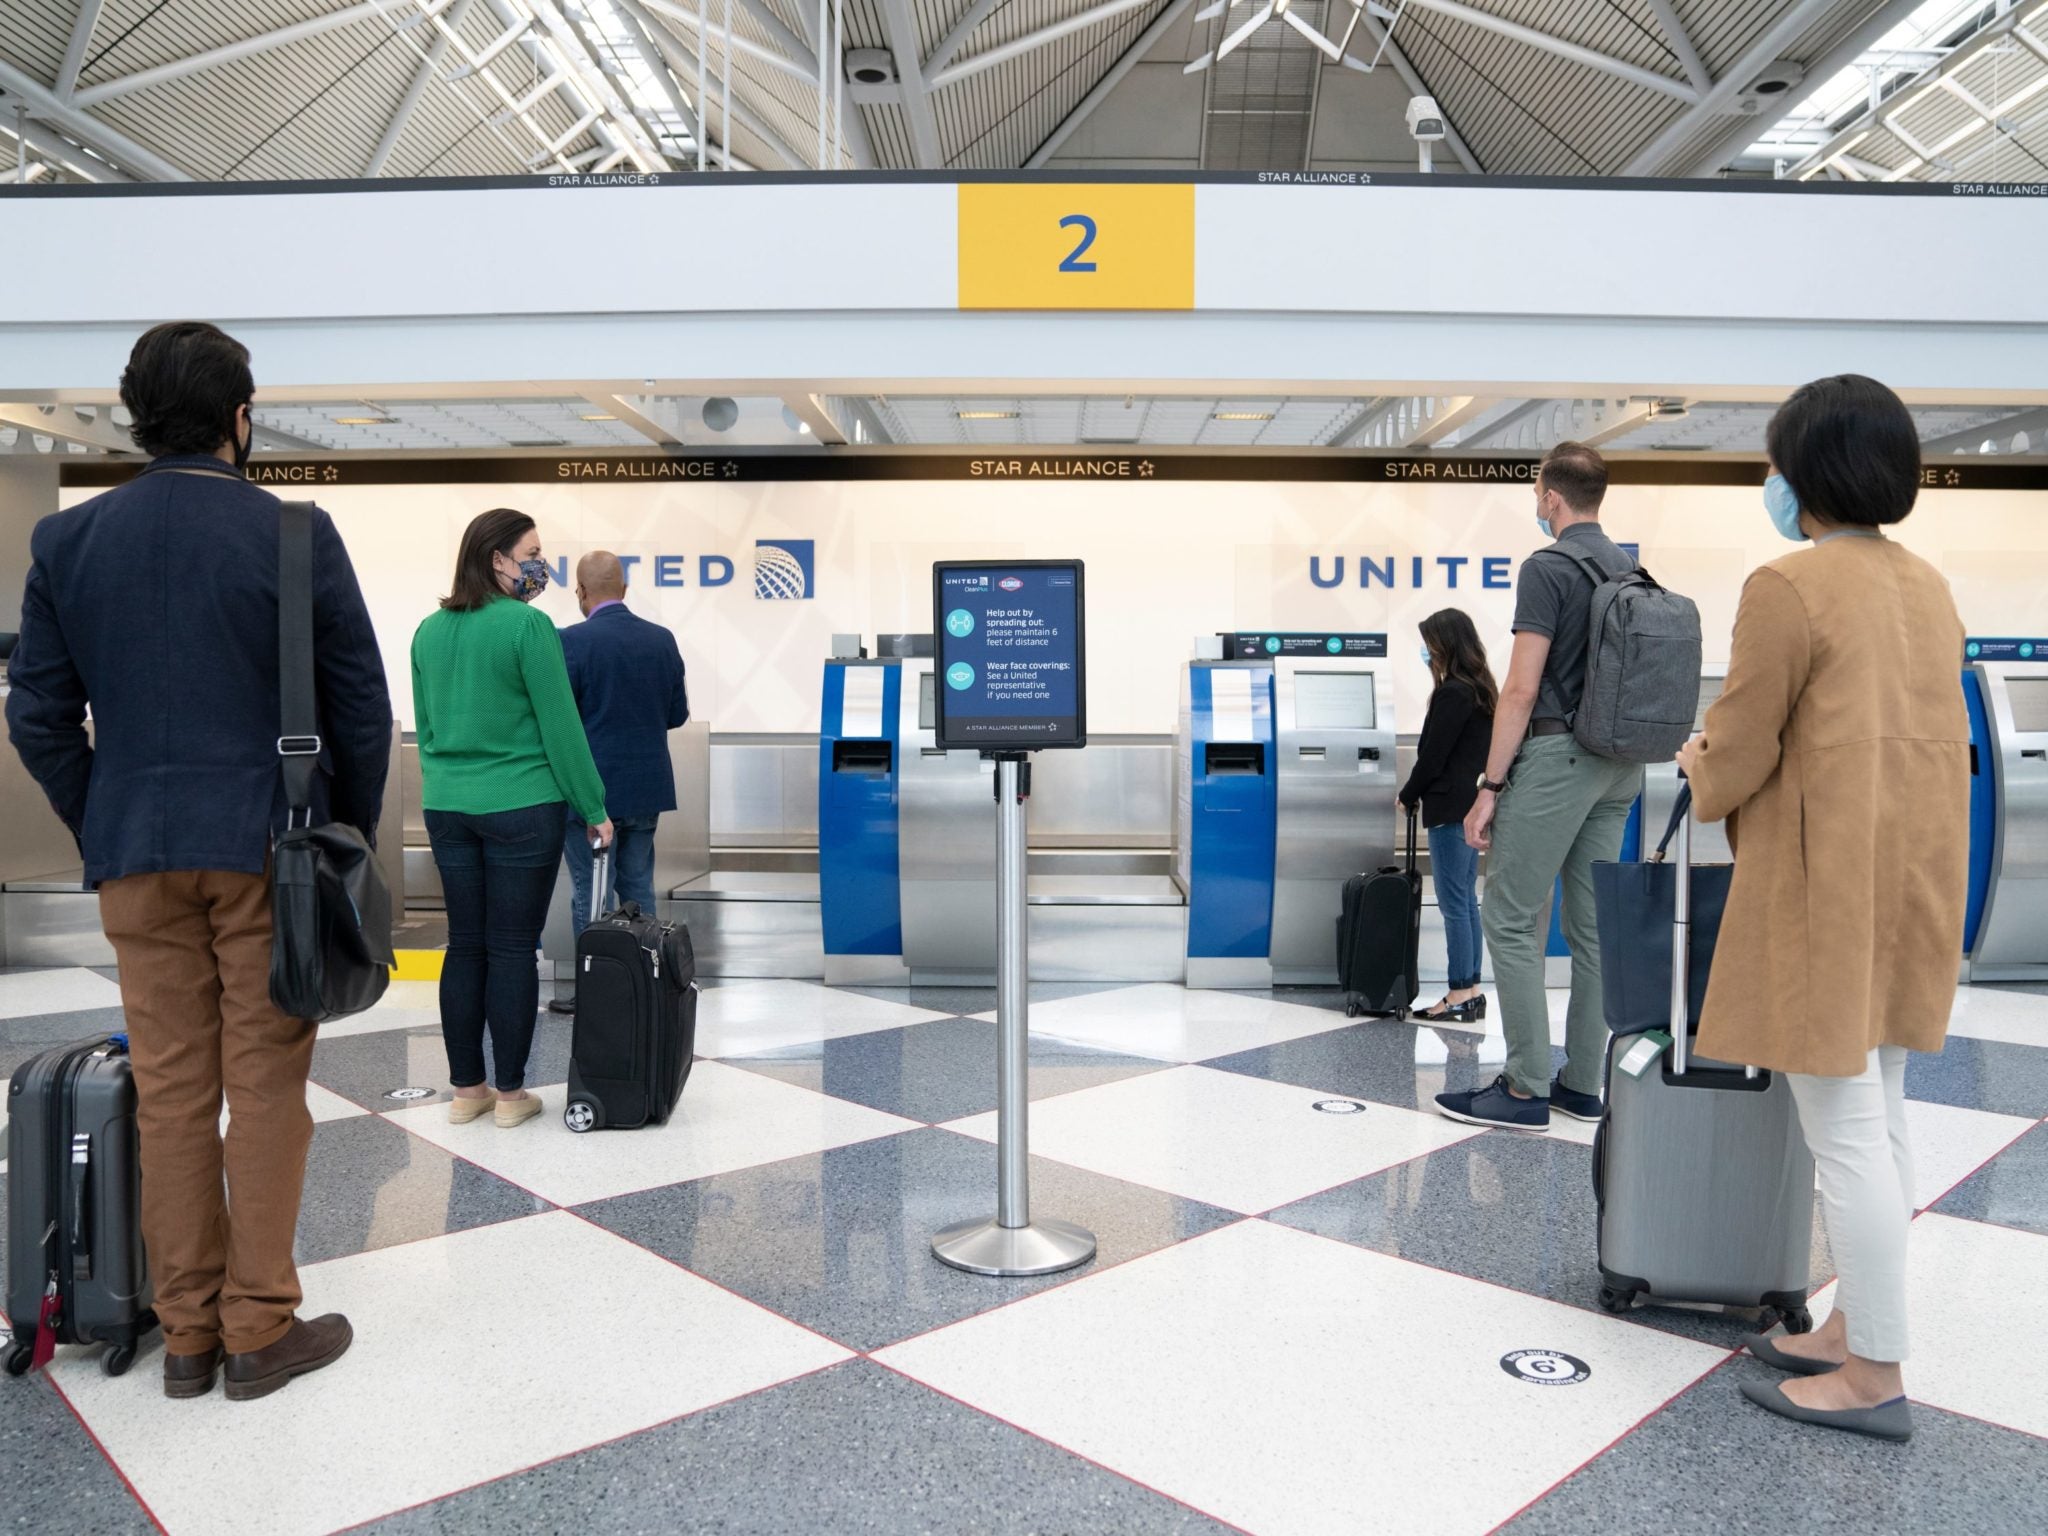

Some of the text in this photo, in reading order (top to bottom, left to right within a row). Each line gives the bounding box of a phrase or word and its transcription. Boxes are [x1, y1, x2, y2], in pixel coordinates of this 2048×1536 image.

[548, 175, 645, 186] STAR ALLIANCE
[1258, 172, 1356, 183] STAR ALLIANCE
[1953, 184, 2048, 194] STAR ALLIANCE
[1057, 214, 1098, 273] 2
[245, 466, 316, 481] LIANCE
[558, 462, 715, 477] STAR ALLIANCE
[970, 461, 1130, 476] STAR ALLIANCE
[1385, 463, 1541, 479] STAR ALLIANCE
[1309, 556, 1512, 589] UNITE
[986, 609, 1005, 617] Help
[1023, 609, 1033, 617] by
[986, 619, 1027, 627] spreading
[986, 628, 1058, 637] please maintain 6
[986, 638, 1049, 646] feet of distance
[1029, 662, 1071, 670] coverings:
[987, 672, 1002, 680] See
[1010, 671, 1037, 679] United
[987, 681, 1046, 690] representative
[987, 691, 993, 699] if
[995, 692, 1011, 700] you
[1012, 691, 1033, 699] need
[1520, 1374, 1579, 1385] spreading
